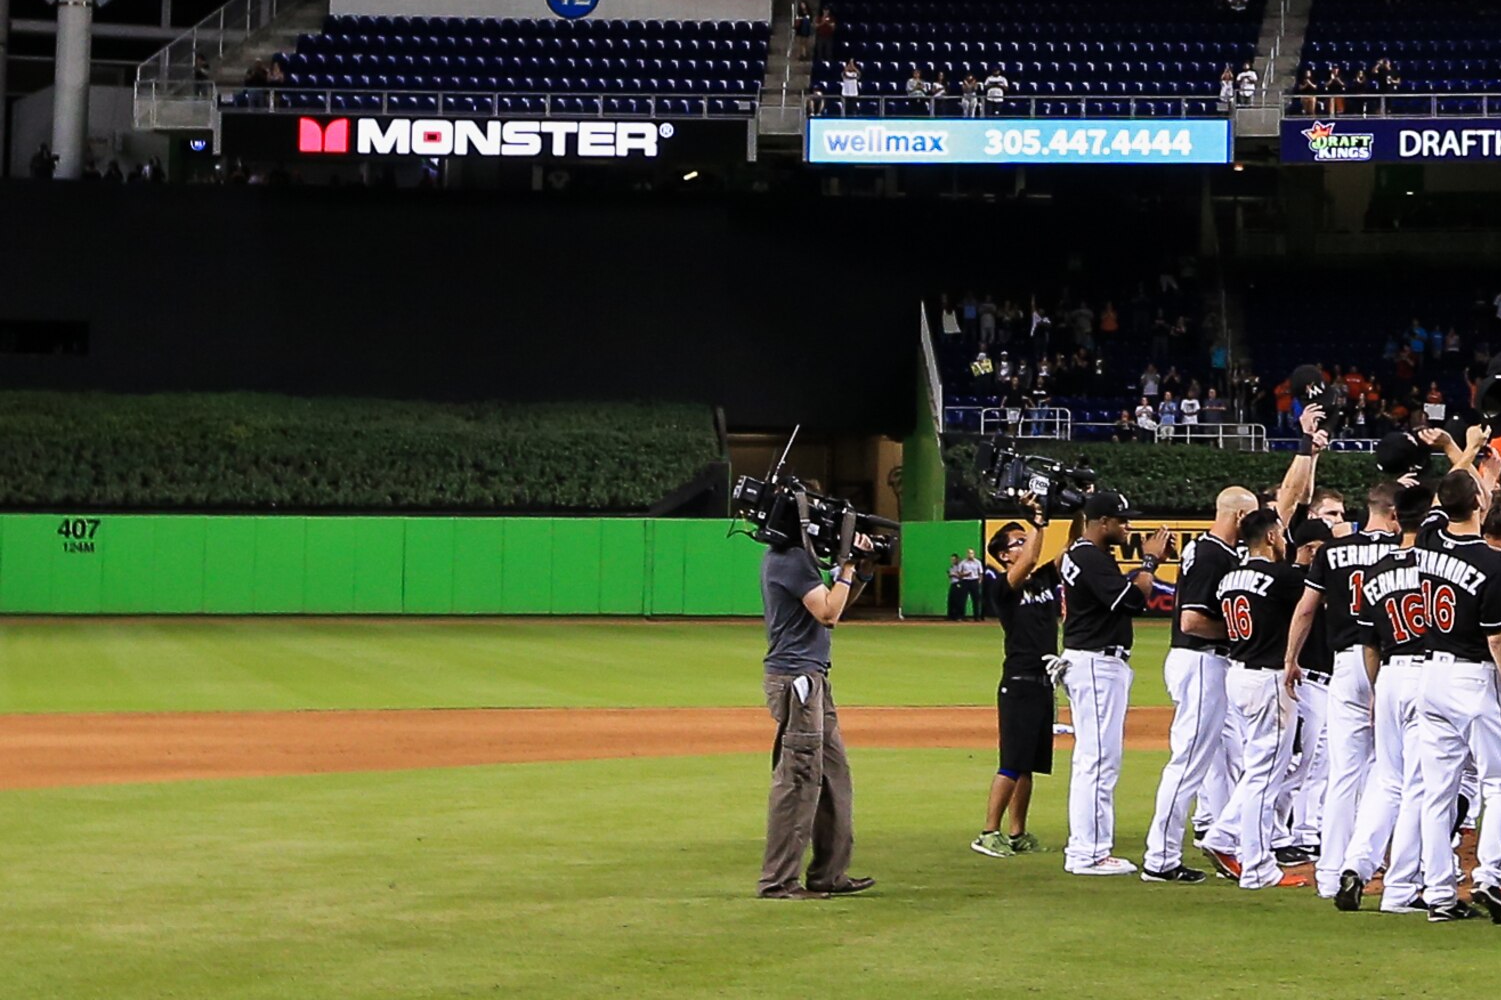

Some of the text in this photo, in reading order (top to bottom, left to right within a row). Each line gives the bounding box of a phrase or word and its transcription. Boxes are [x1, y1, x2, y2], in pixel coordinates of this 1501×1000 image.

[825, 128, 1193, 157] wellmax 305.447.4444
[1311, 136, 1371, 149] DRAFT
[1317, 147, 1371, 160] KINGS
[57, 518, 101, 540] 407
[1222, 594, 1253, 641] 16
